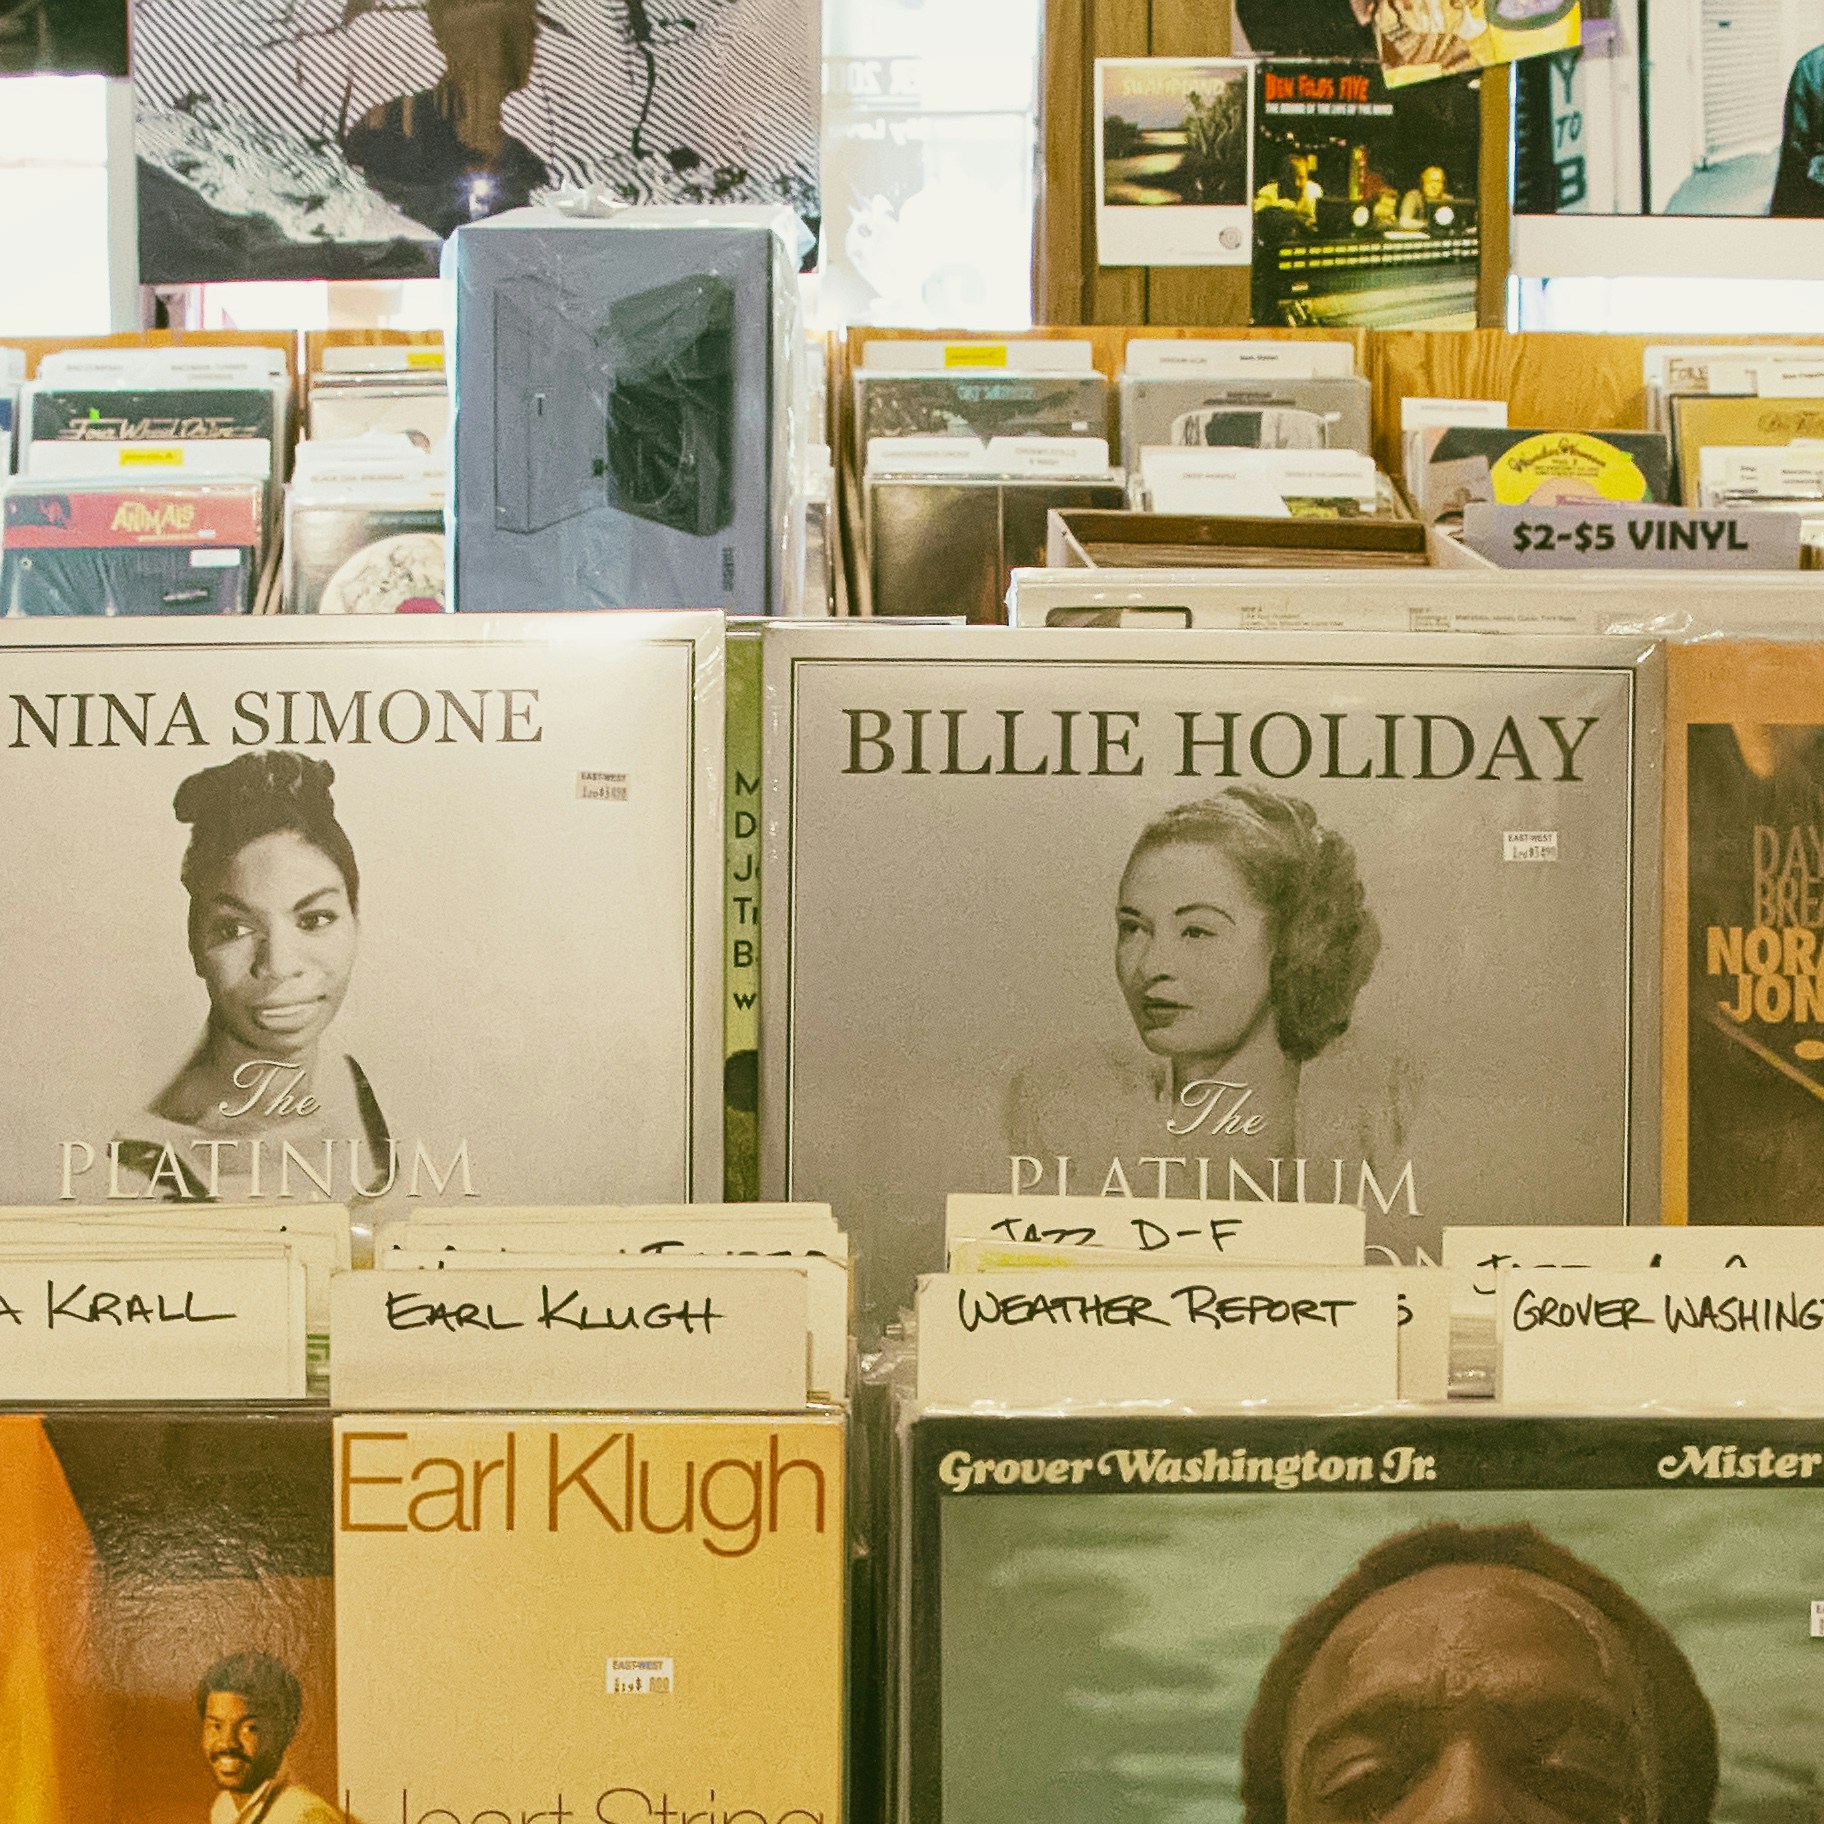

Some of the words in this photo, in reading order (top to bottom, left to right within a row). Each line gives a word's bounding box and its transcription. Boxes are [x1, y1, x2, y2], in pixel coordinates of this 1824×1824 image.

[1512, 519, 1616, 554] $2-$5
[1628, 520, 1749, 552] VINYL
[8, 691, 210, 750] NINA
[230, 687, 545, 746] SIMONE
[841, 709, 1146, 777] BILLIE
[1173, 710, 1601, 784] HOLIDAY
[219, 1060, 321, 1119] The
[1165, 1078, 1267, 1138] The
[59, 1138, 483, 1200] PLATINUM
[1007, 1155, 1425, 1218] PLATINUM
[1130, 1218, 1244, 1254] D-F
[45, 1279, 238, 1331] KRALL
[385, 1291, 526, 1332] EARL
[537, 1284, 728, 1335] KLUGH
[957, 1288, 1173, 1332] WEATHER
[1171, 1290, 1358, 1332] REPORT
[1510, 1288, 1654, 1332] GROVER
[938, 1448, 1095, 1494] Grover
[1097, 1445, 1373, 1489] Washington
[1380, 1445, 1439, 1487] Jr.
[1657, 1443, 1824, 1481] Mister
[338, 1431, 519, 1535] Earl
[546, 1434, 828, 1558] Klugh
